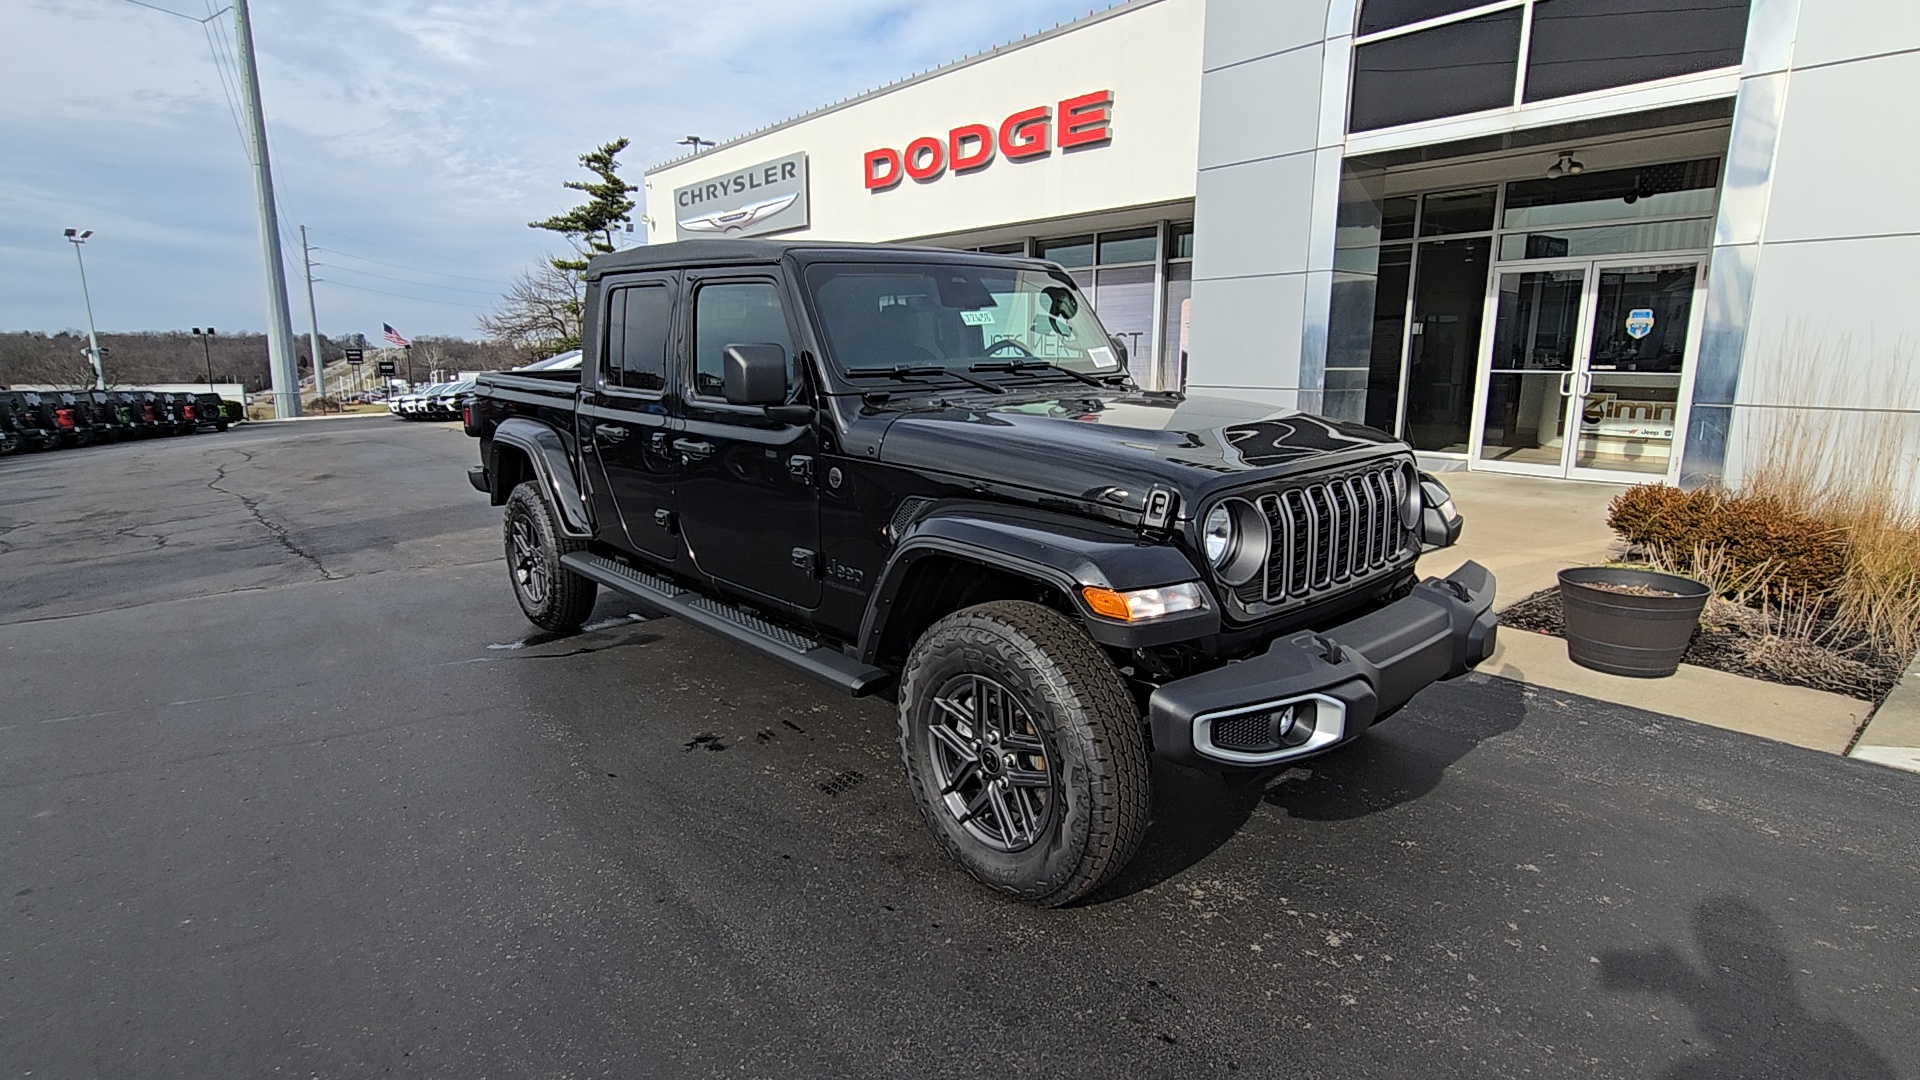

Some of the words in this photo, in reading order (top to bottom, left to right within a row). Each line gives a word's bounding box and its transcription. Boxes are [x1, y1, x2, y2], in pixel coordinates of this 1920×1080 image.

[864, 90, 1113, 191] DODGE
[678, 161, 797, 208] CHRYSLER
[826, 558, 864, 587] Jeep
